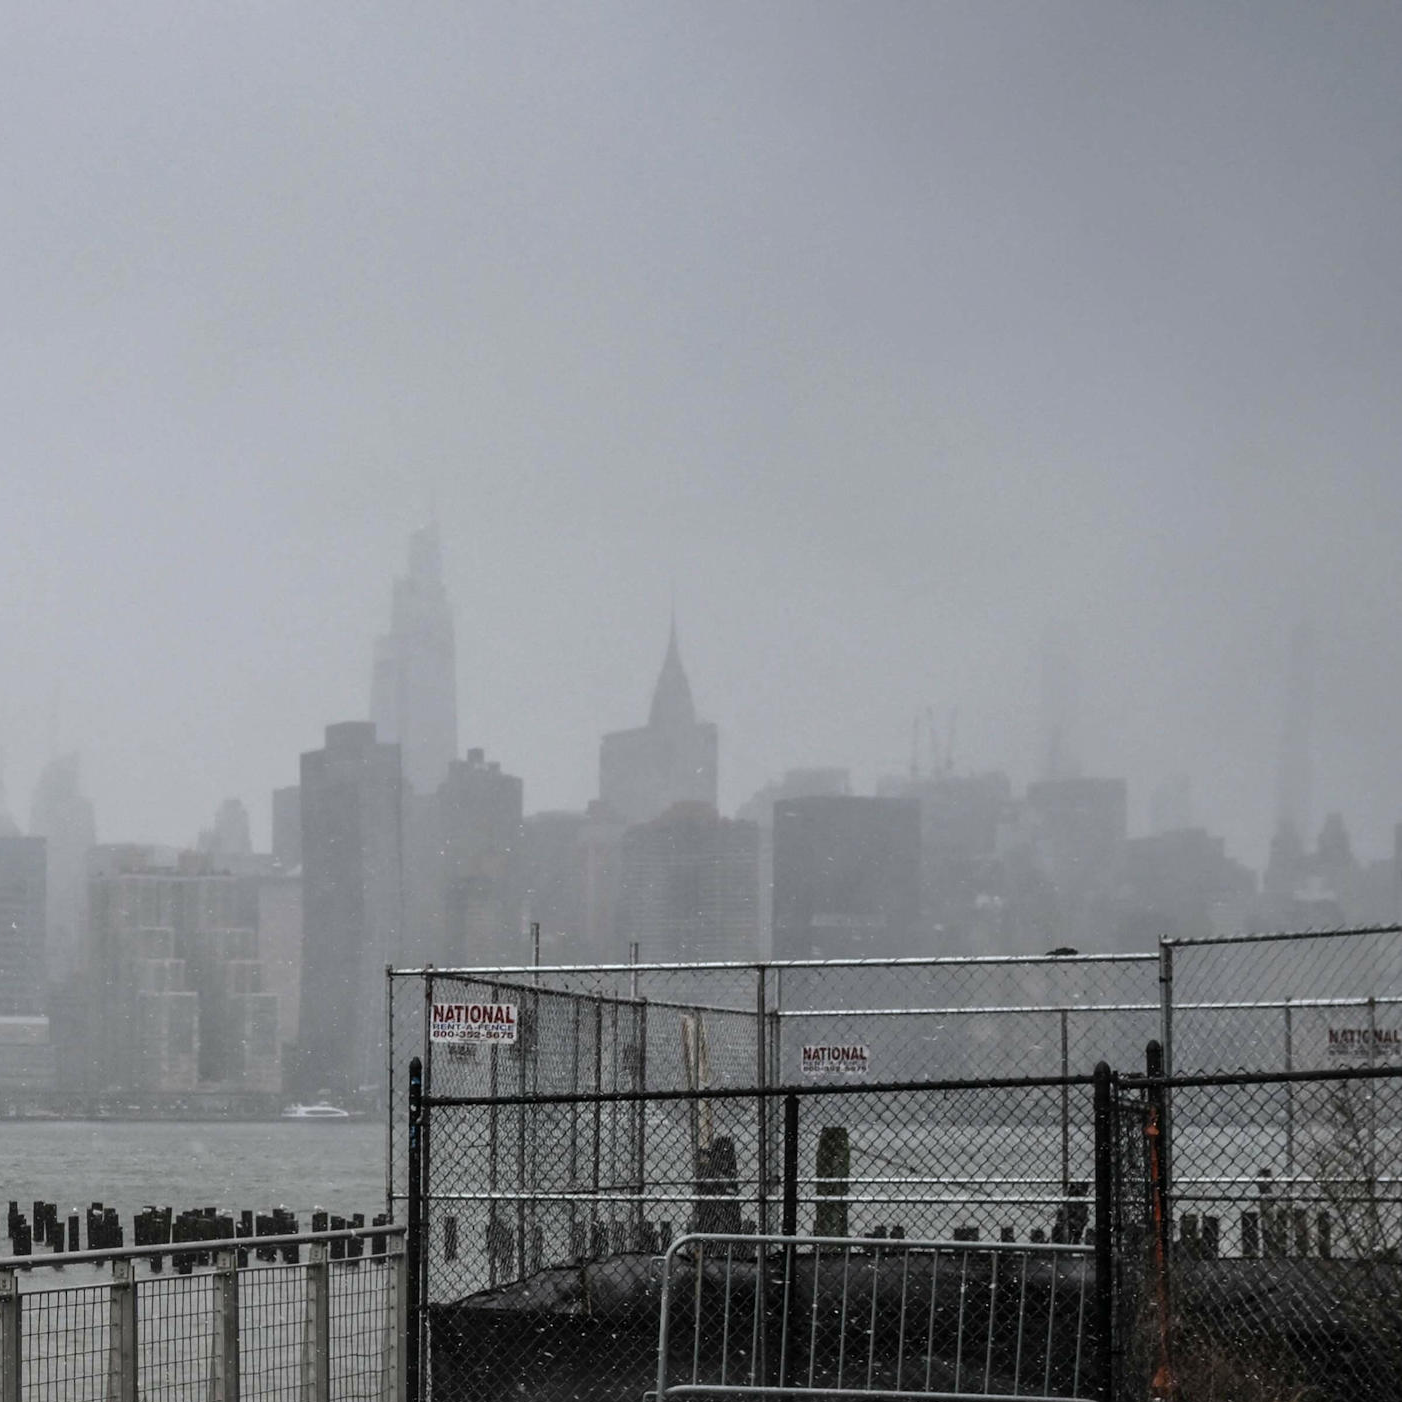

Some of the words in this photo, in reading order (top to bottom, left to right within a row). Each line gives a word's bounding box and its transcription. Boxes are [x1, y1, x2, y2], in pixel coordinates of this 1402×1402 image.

[433, 1005, 515, 1024] NATIONAL
[432, 1023, 514, 1031] RENT-A-FENCE
[803, 1047, 867, 1060] NATIONAL
